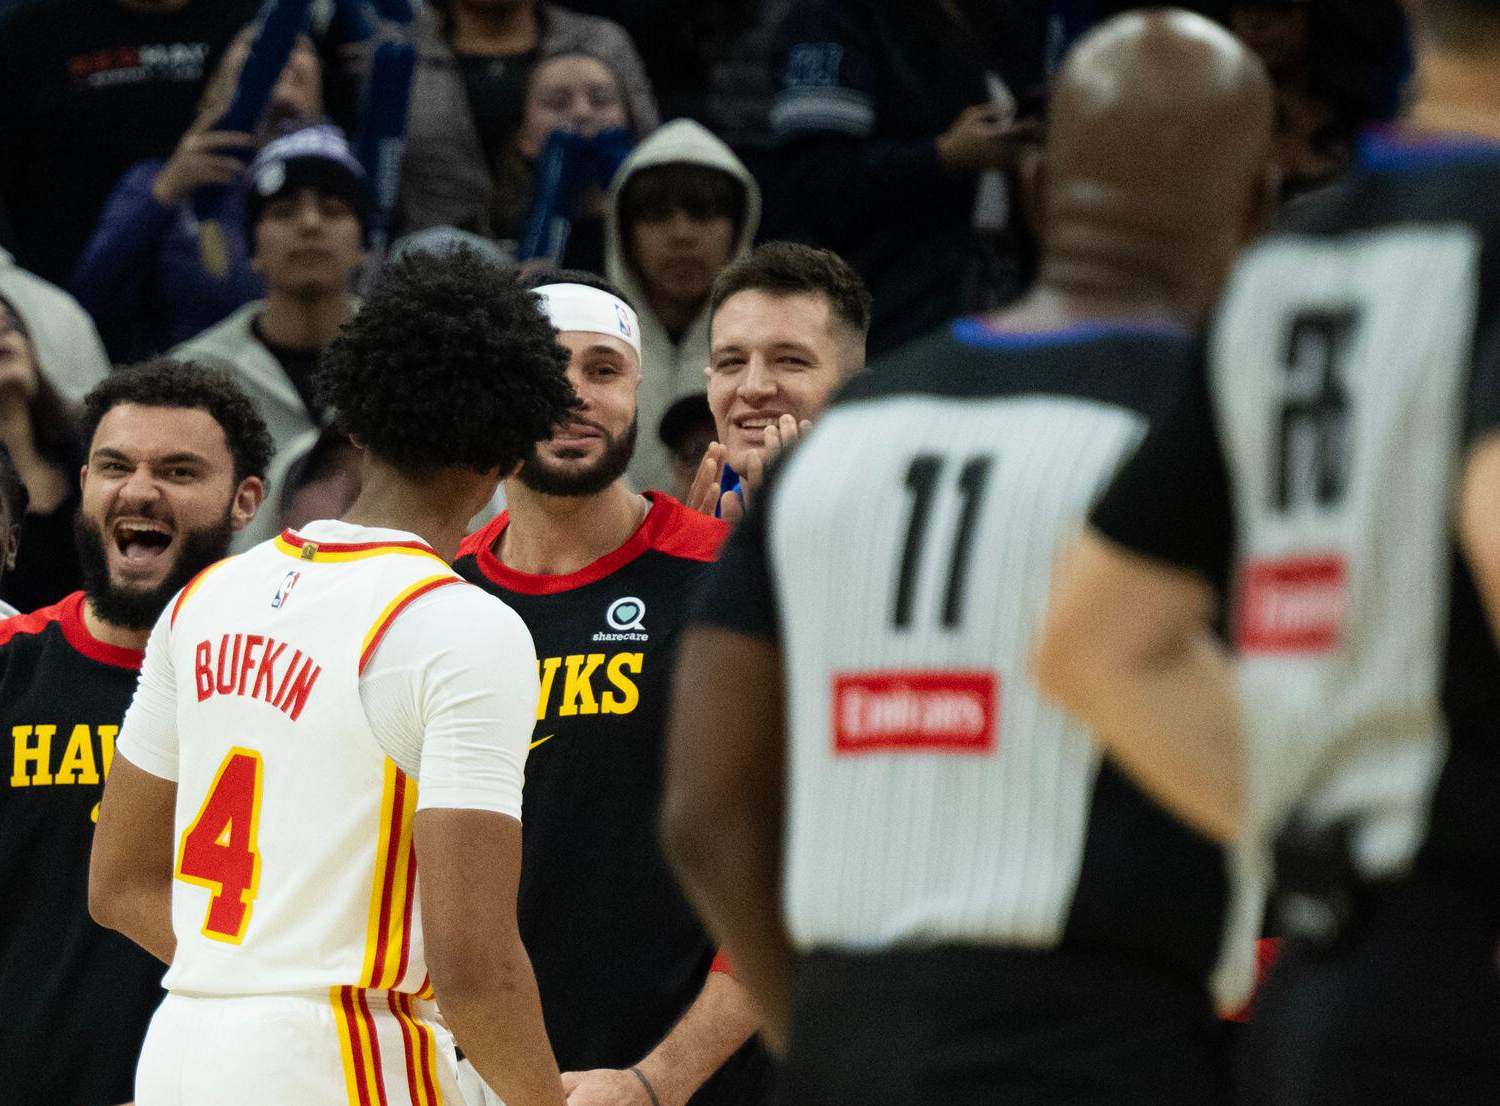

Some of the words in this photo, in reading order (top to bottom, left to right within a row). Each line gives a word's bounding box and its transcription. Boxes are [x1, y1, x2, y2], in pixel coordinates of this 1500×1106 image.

[891, 451, 996, 634] 11
[195, 633, 322, 722] BUFKIN
[592, 631, 649, 642] sharecare
[174, 745, 264, 946] 4
